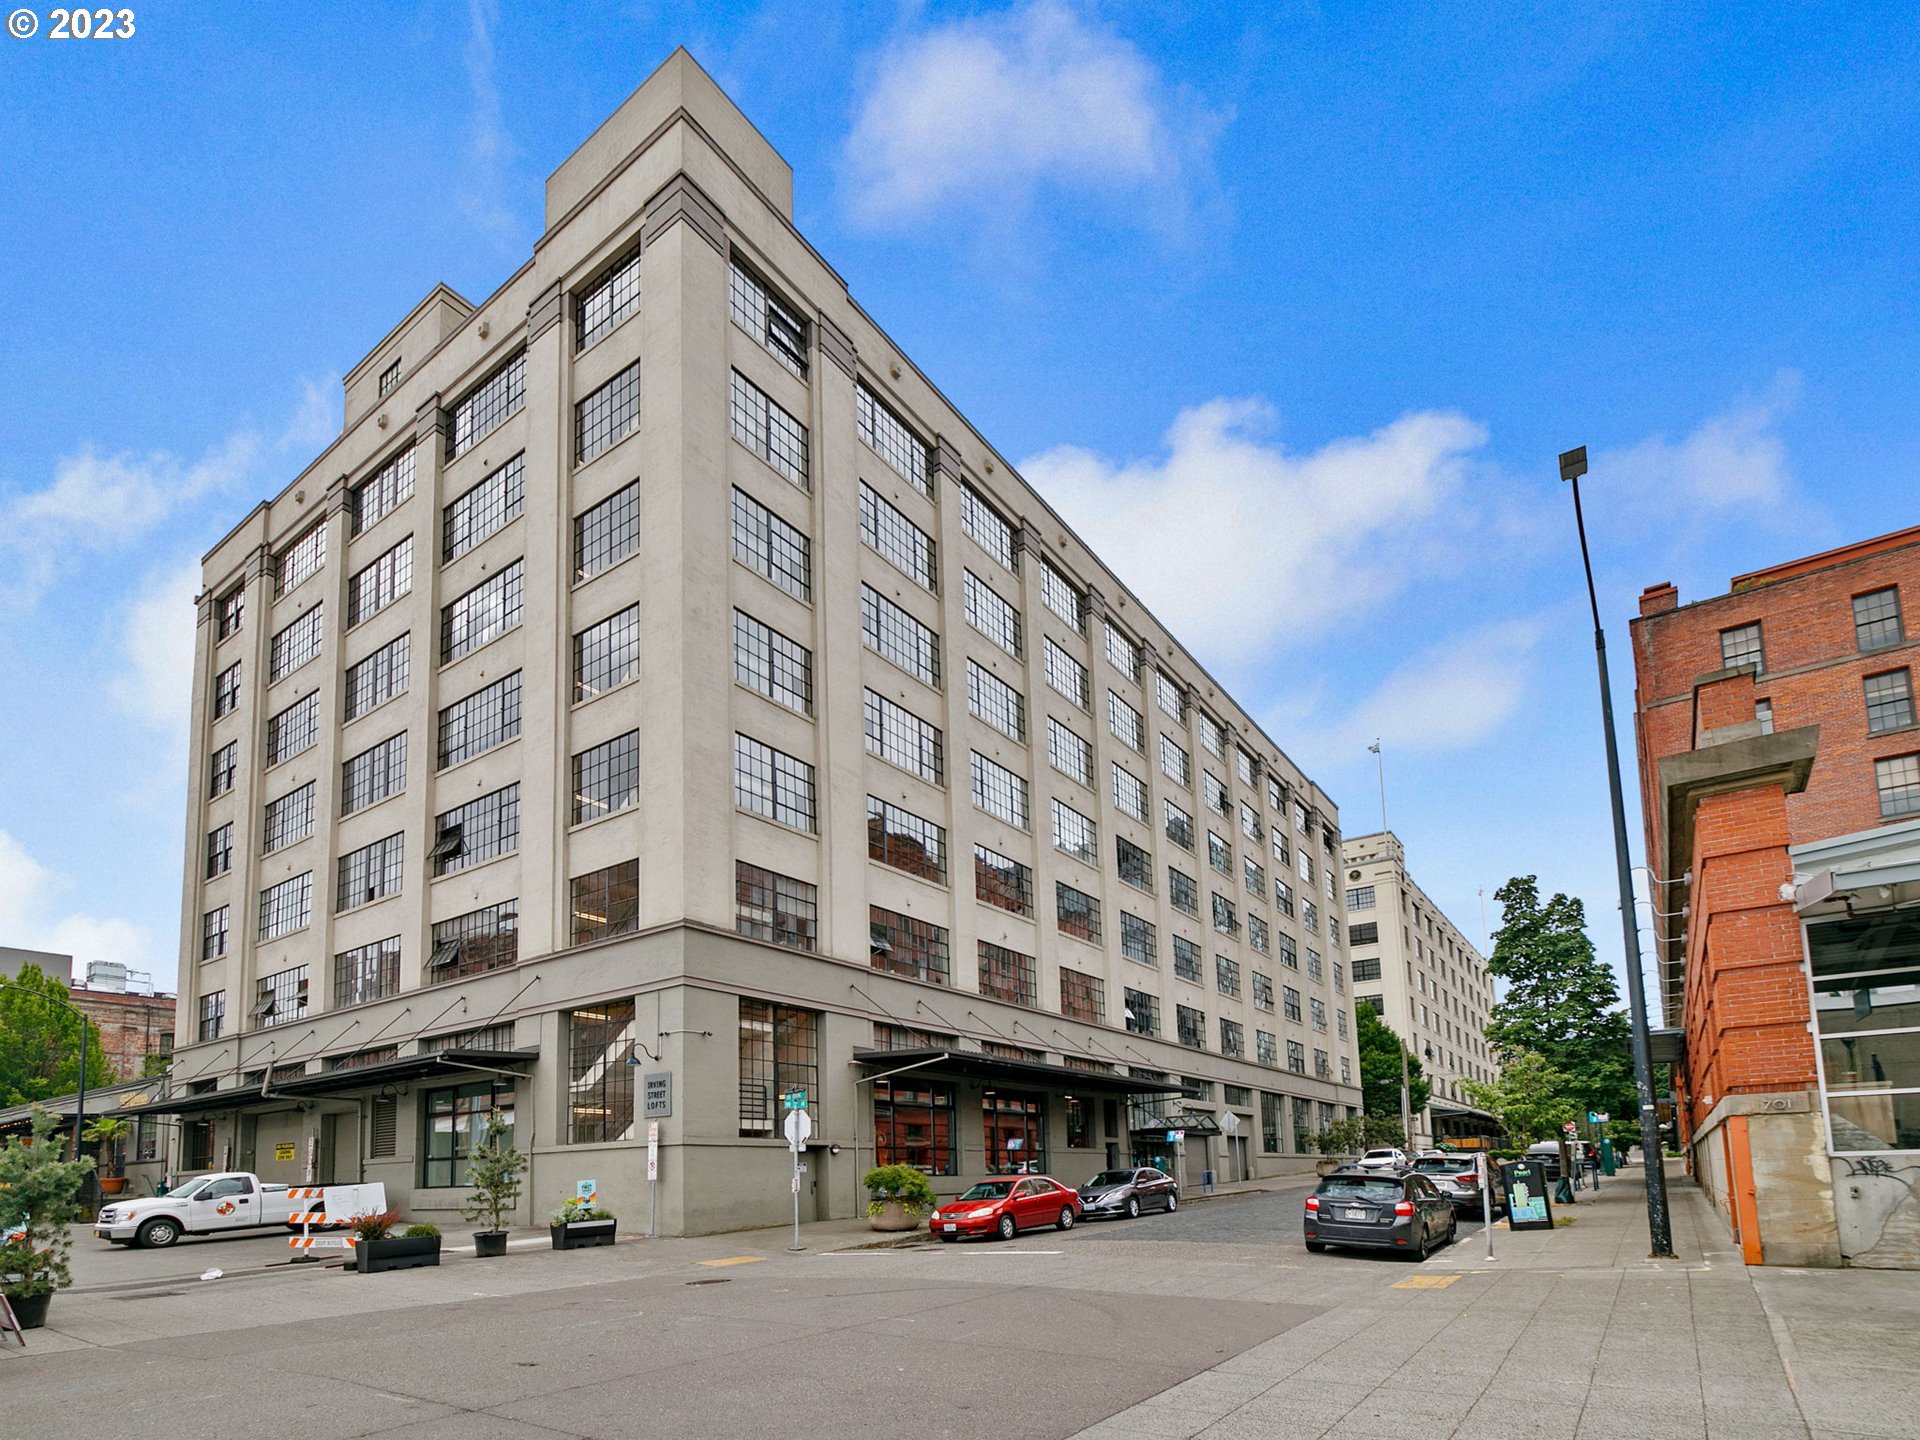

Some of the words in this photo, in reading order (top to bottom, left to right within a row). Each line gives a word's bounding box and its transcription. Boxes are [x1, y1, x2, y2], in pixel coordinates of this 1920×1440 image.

[647, 1080, 667, 1089] IRVING
[647, 1090, 666, 1100] STREET
[647, 1101, 666, 1110] LOFTS
[1763, 1099, 1791, 1110] 701
